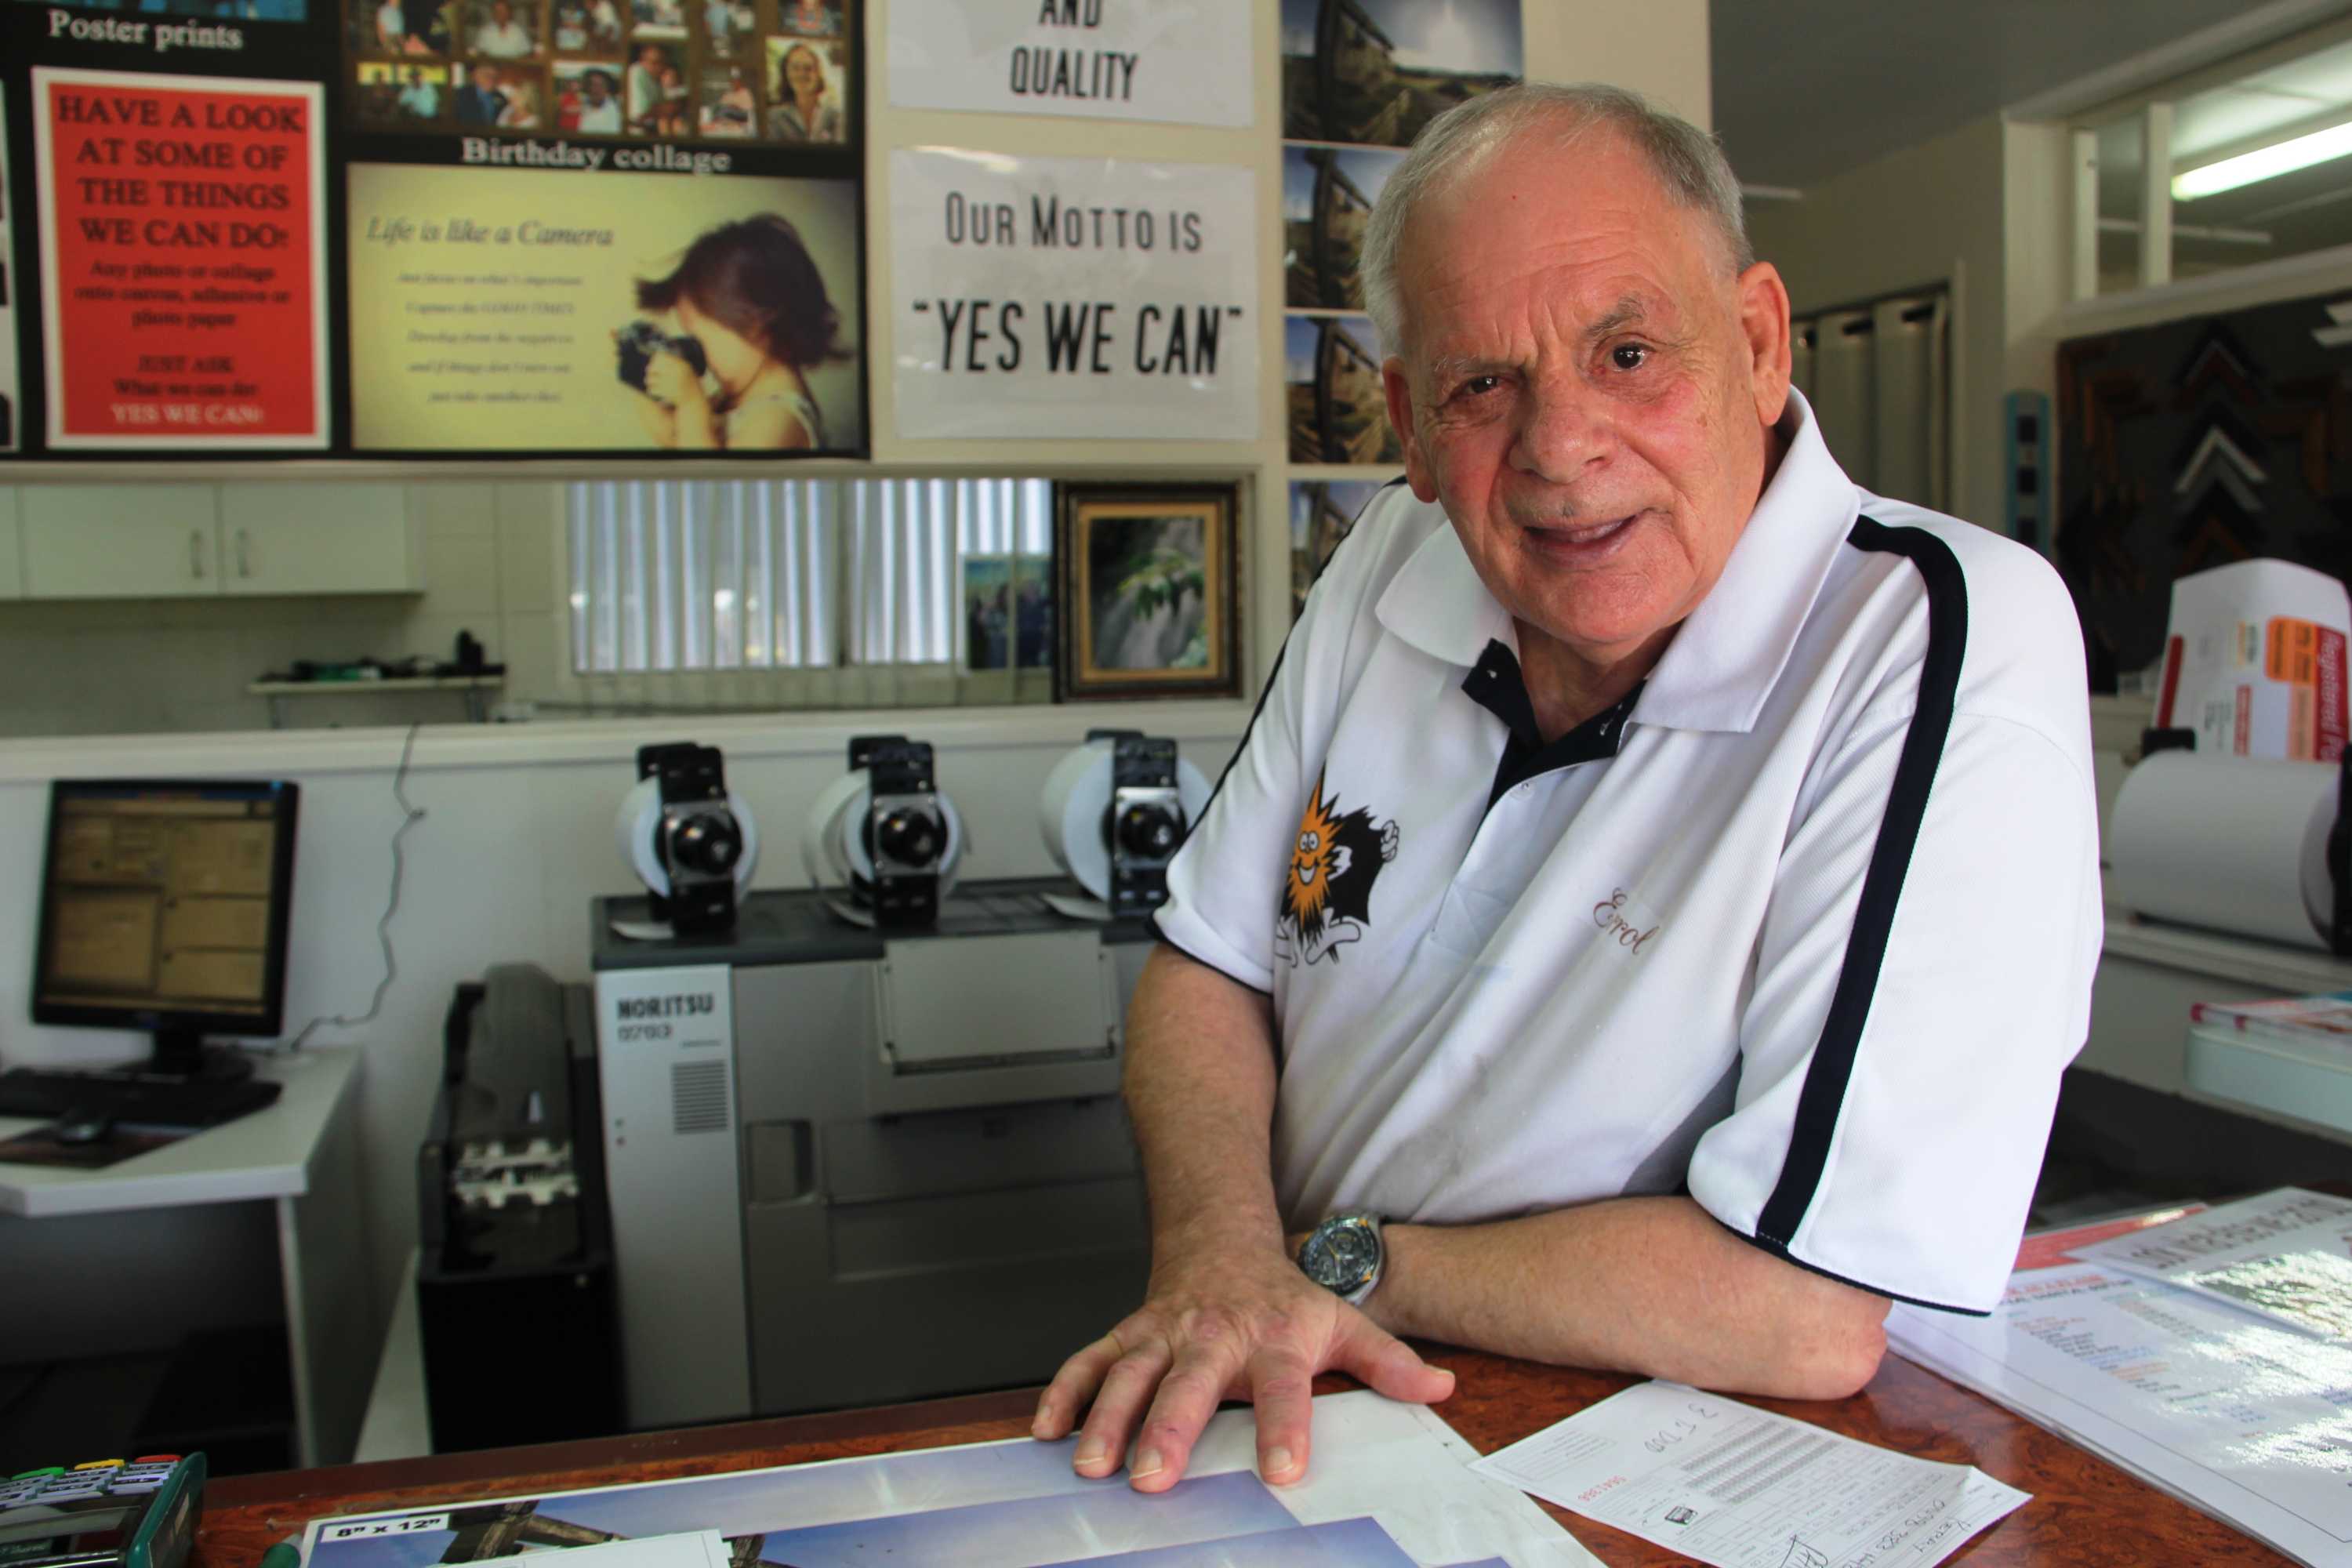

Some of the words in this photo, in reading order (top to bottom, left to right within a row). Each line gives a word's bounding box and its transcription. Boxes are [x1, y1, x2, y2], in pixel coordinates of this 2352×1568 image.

[48, 8, 149, 43] Poster
[154, 18, 244, 52] prints
[1010, 46, 1138, 100] QUALITY
[58, 94, 160, 126] HAVE
[170, 103, 195, 128] A
[204, 103, 303, 133] LOOK
[76, 138, 124, 165] AT
[135, 140, 233, 169] SOME
[242, 144, 289, 171] OF
[462, 136, 605, 173] Birthday
[613, 143, 732, 175] collage
[76, 177, 147, 205] THE
[159, 180, 289, 209] THINGS
[79, 217, 136, 245] WE
[143, 220, 220, 247] CAN
[367, 216, 413, 247] Life
[419, 220, 440, 242] is
[446, 218, 489, 243] like
[493, 226, 511, 244] a
[517, 220, 614, 246] Camera
[1044, 302, 1116, 374] WE
[111, 403, 160, 425] YES
[162, 403, 201, 425] WE
[1592, 887, 1660, 955] Errol
[617, 992, 714, 1019] NORITSU
